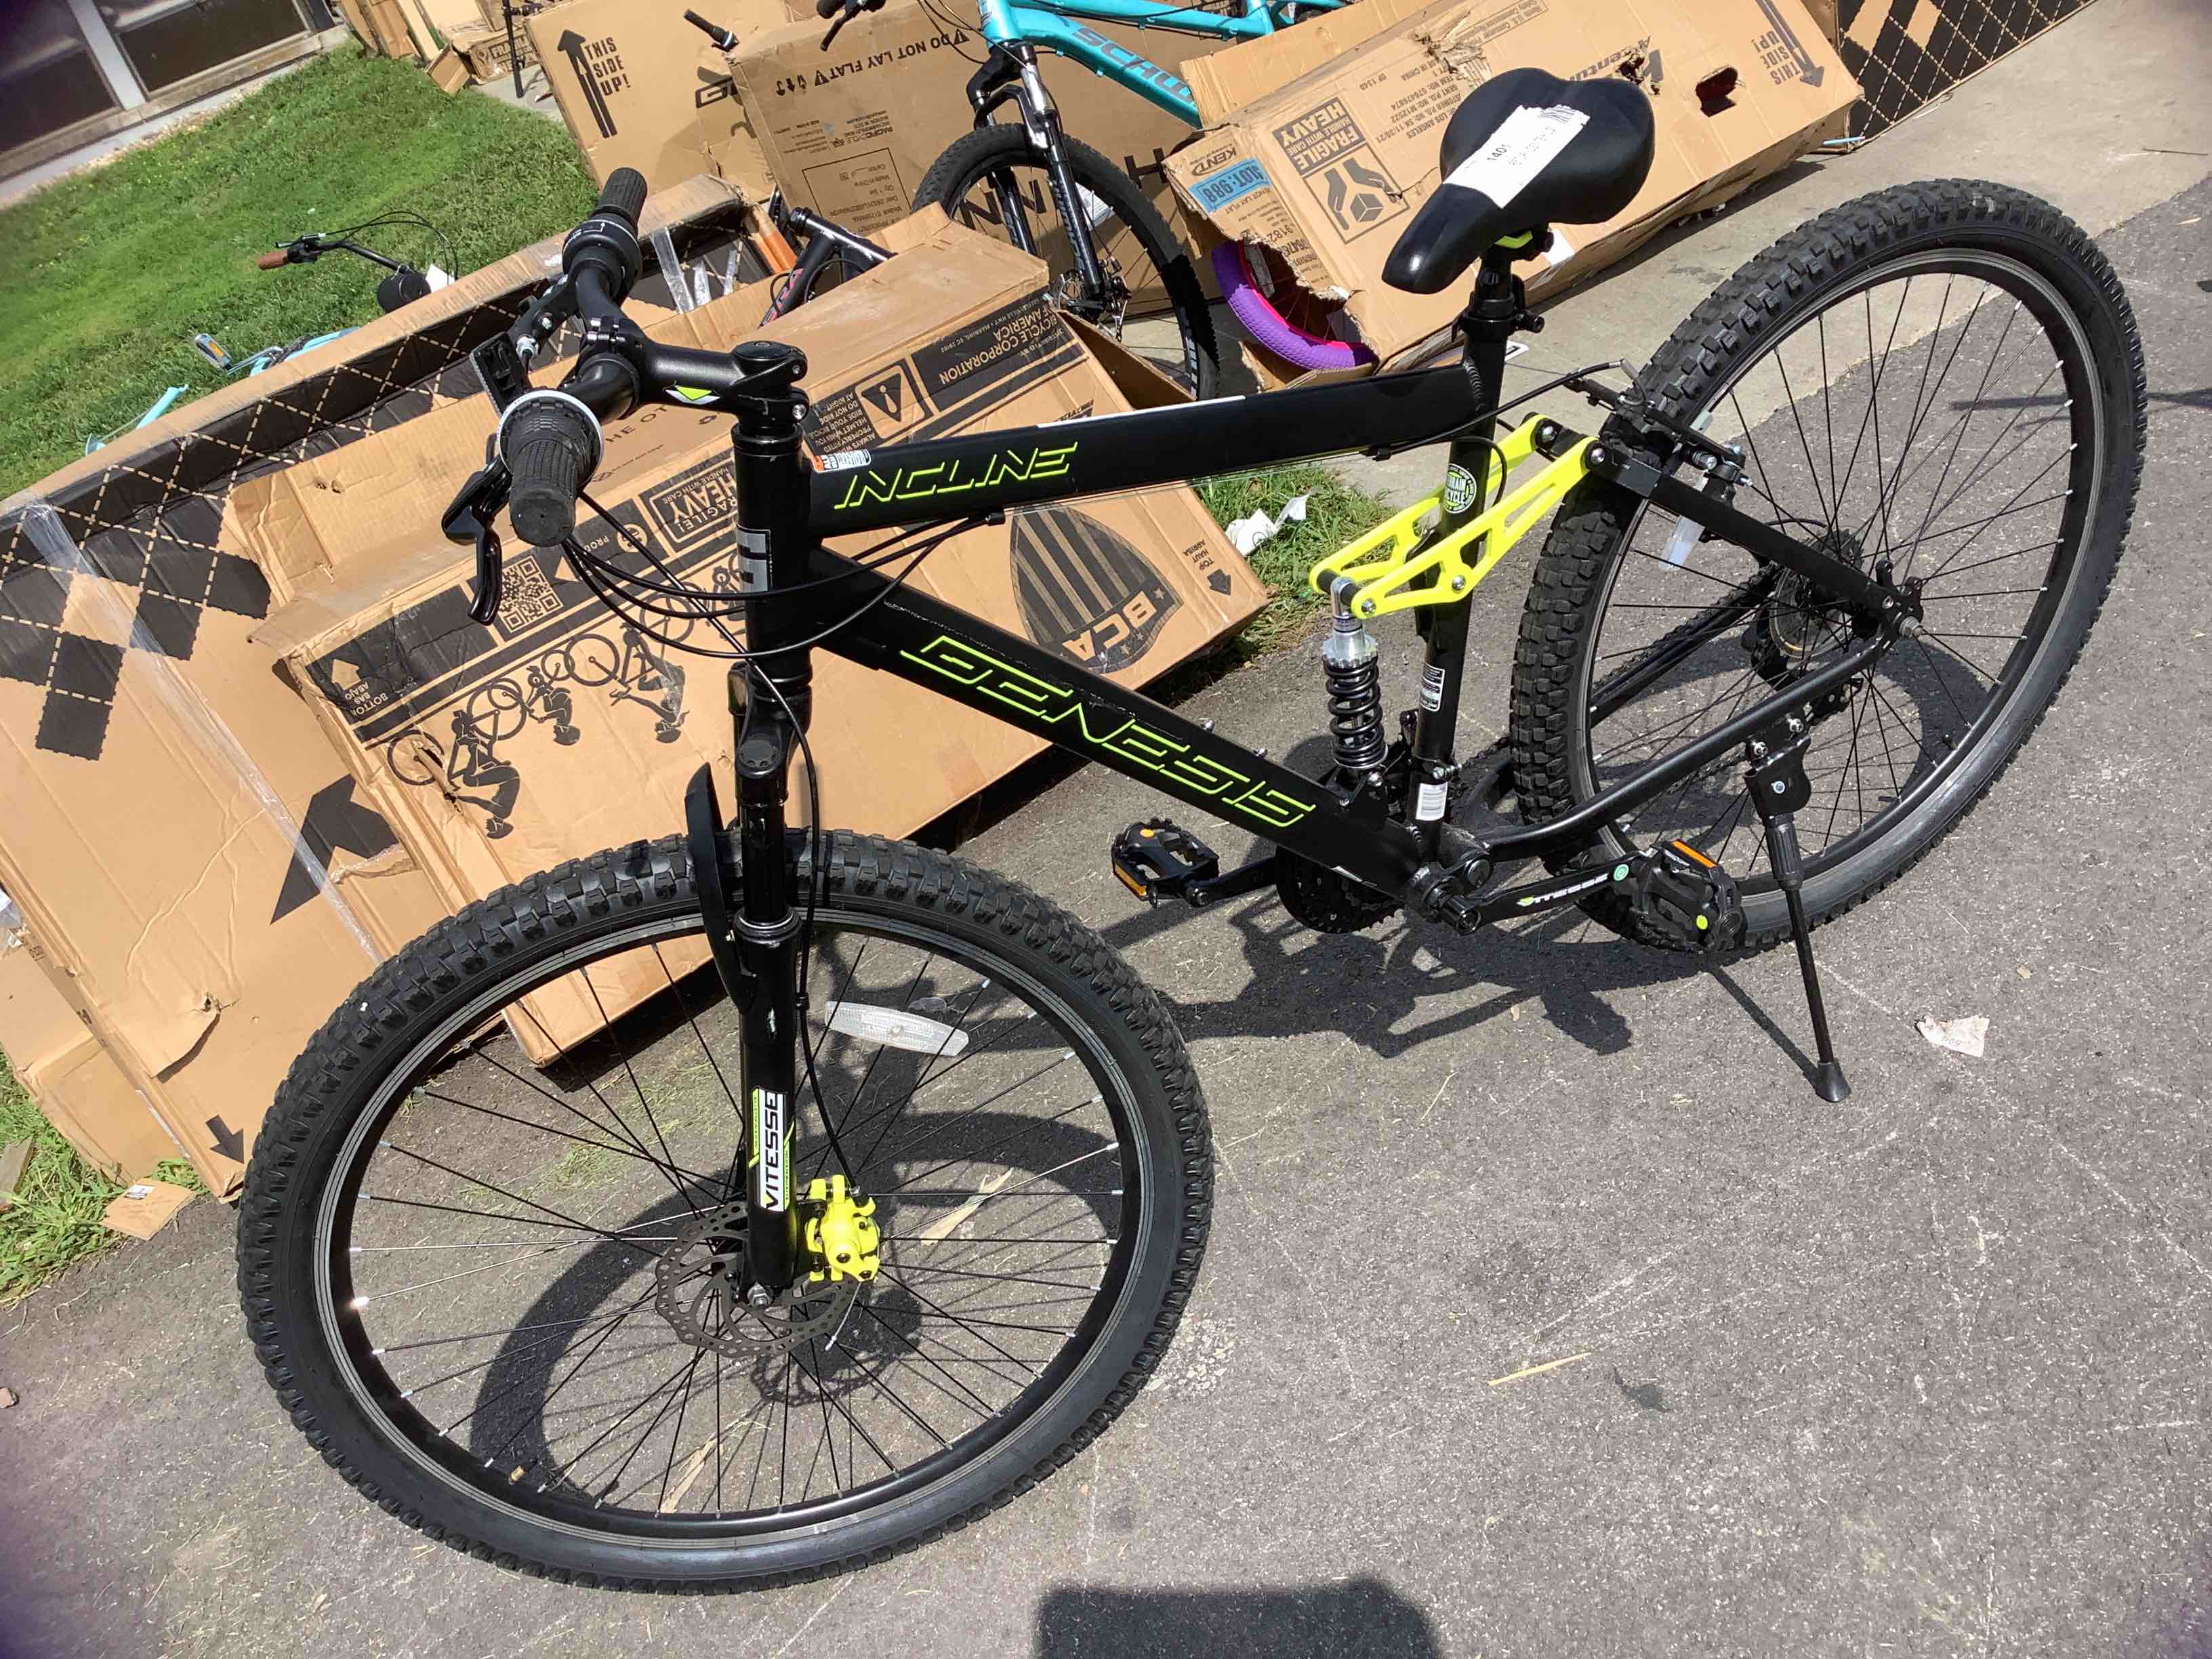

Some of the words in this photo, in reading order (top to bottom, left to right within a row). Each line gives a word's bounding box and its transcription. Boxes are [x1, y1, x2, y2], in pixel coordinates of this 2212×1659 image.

[584, 36, 617, 60] THIS
[895, 41, 926, 59] NOT
[928, 33, 950, 49] DO
[1750, 28, 1780, 54] UP!
[592, 54, 623, 77] SIDE
[866, 50, 893, 68] LAY
[1759, 44, 1790, 70] SIDE
[827, 60, 862, 80] FLAT
[1399, 66, 1421, 83] CHINA
[1769, 61, 1800, 85] THIS
[600, 73, 630, 96] UP!
[1279, 101, 1346, 147] HEAVY
[1322, 117, 1351, 136] HANDLE
[1405, 118, 1436, 140] ANGELES
[1286, 140, 1306, 156] CARE
[1292, 125, 1359, 171] FRAGILE
[1305, 131, 1324, 146] WITH
[1193, 145, 1237, 173] KENT
[1201, 177, 1233, 204] 988
[992, 308, 1044, 342] AMERICA
[1018, 314, 1057, 342] BICYCLE
[938, 334, 1020, 384] CORPORATION
[844, 392, 854, 401] AT
[846, 400, 857, 409] DO
[819, 412, 834, 424] RIDE
[834, 405, 847, 416] NOT
[846, 409, 862, 420] RIDE
[829, 416, 846, 429] YOUR
[842, 417, 867, 433] HELMET
[839, 424, 871, 445] PROPERLY
[852, 432, 876, 449] ALWAYS
[823, 439, 841, 453] FITTED
[701, 467, 728, 484] HANDLE
[834, 441, 1079, 510] INCLINE
[681, 480, 700, 494] WITH
[661, 490, 682, 504] CARE
[670, 472, 737, 524] HEAVY
[677, 495, 738, 532] RAGILE!
[583, 535, 609, 553] PROD
[1183, 539, 1205, 556] ARRIBA
[1191, 548, 1209, 562] HAUT
[1197, 556, 1214, 571] TOP
[1061, 595, 1158, 656] BCA
[344, 681, 369, 700] ABAJO
[353, 691, 370, 705] BAS
[900, 634, 1315, 836] GENESIS
[763, 1091, 782, 1210] VITESSE
